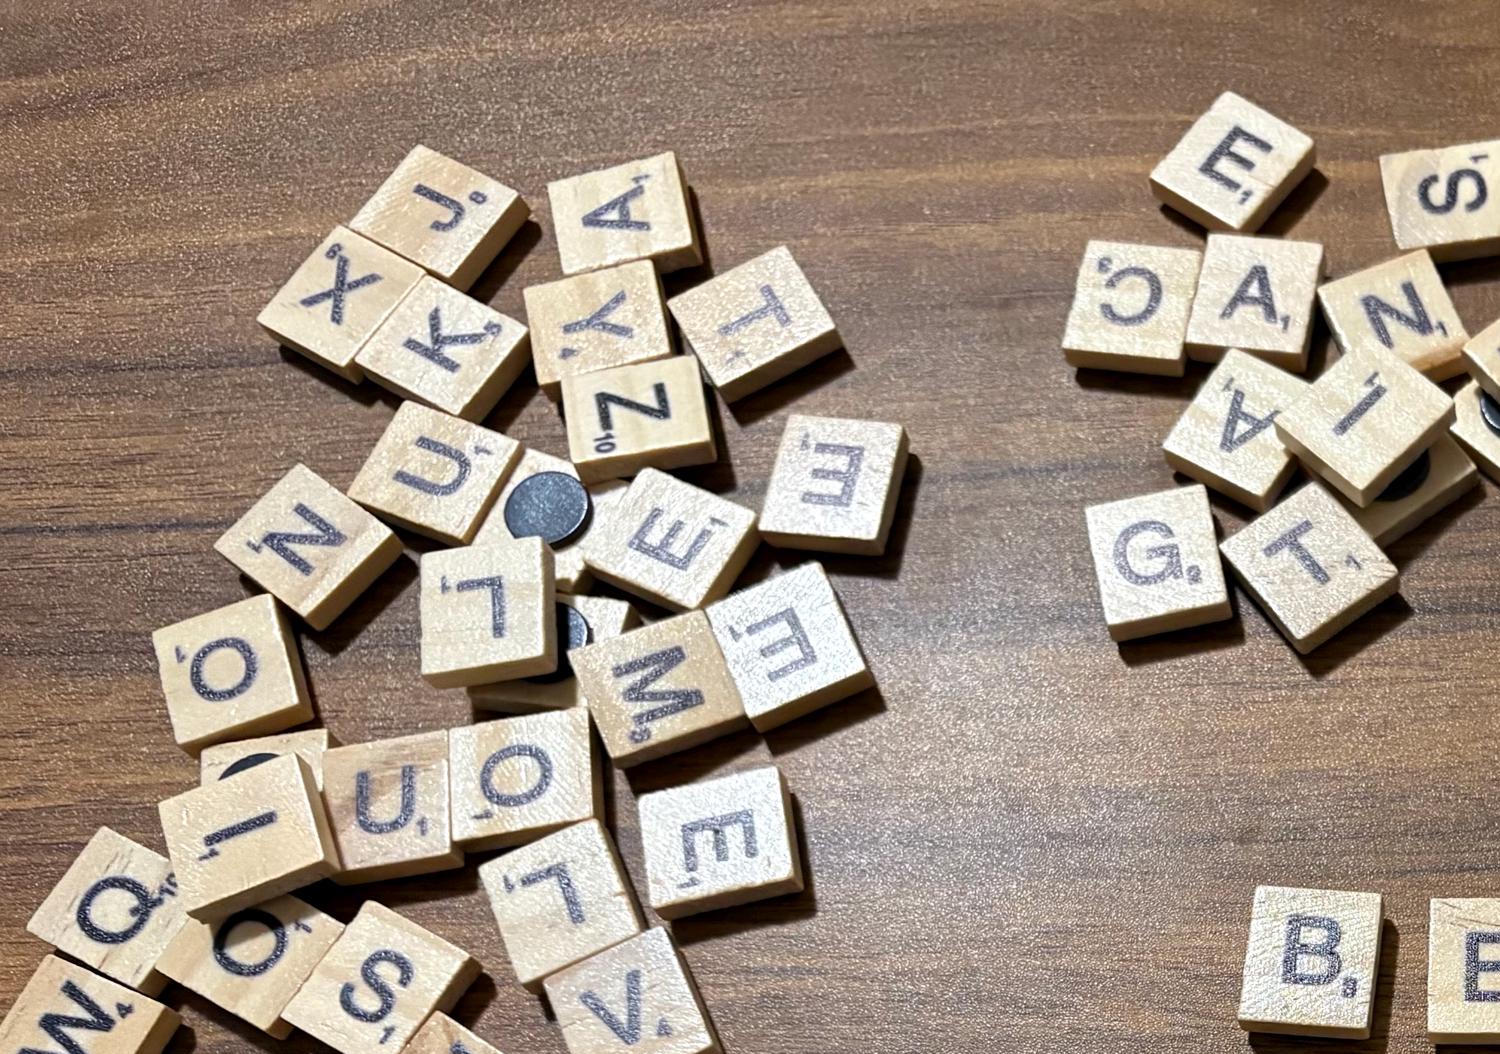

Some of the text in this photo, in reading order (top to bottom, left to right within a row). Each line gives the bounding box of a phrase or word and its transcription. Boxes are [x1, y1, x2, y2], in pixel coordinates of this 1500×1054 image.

[1199, 125, 1273, 192] E
[413, 184, 465, 233] J
[583, 183, 651, 231] A
[1417, 168, 1489, 216] S
[301, 252, 380, 325] X
[563, 291, 635, 338] Y
[718, 284, 791, 337] T
[1101, 266, 1164, 326] C
[1220, 264, 1279, 322] A
[1361, 281, 1435, 349] N
[404, 310, 487, 373] K
[594, 382, 672, 454] Z 10
[1220, 390, 1279, 452] A
[1335, 385, 1386, 435] I
[394, 436, 471, 496] U
[801, 442, 865, 508] E
[260, 503, 348, 576] N
[627, 507, 712, 571] E
[1114, 521, 1179, 585] G
[1265, 518, 1331, 585] T
[456, 576, 506, 638] L
[190, 636, 258, 703] O
[746, 607, 817, 683] E
[612, 645, 705, 724] M
[355, 765, 417, 836] U
[479, 744, 552, 808] O
[205, 811, 278, 847] I
[681, 812, 757, 873] E
[76, 876, 164, 945] Q
[521, 864, 586, 924] L
[213, 909, 287, 977] O
[339, 950, 414, 1025] S
[581, 970, 641, 1046] V
